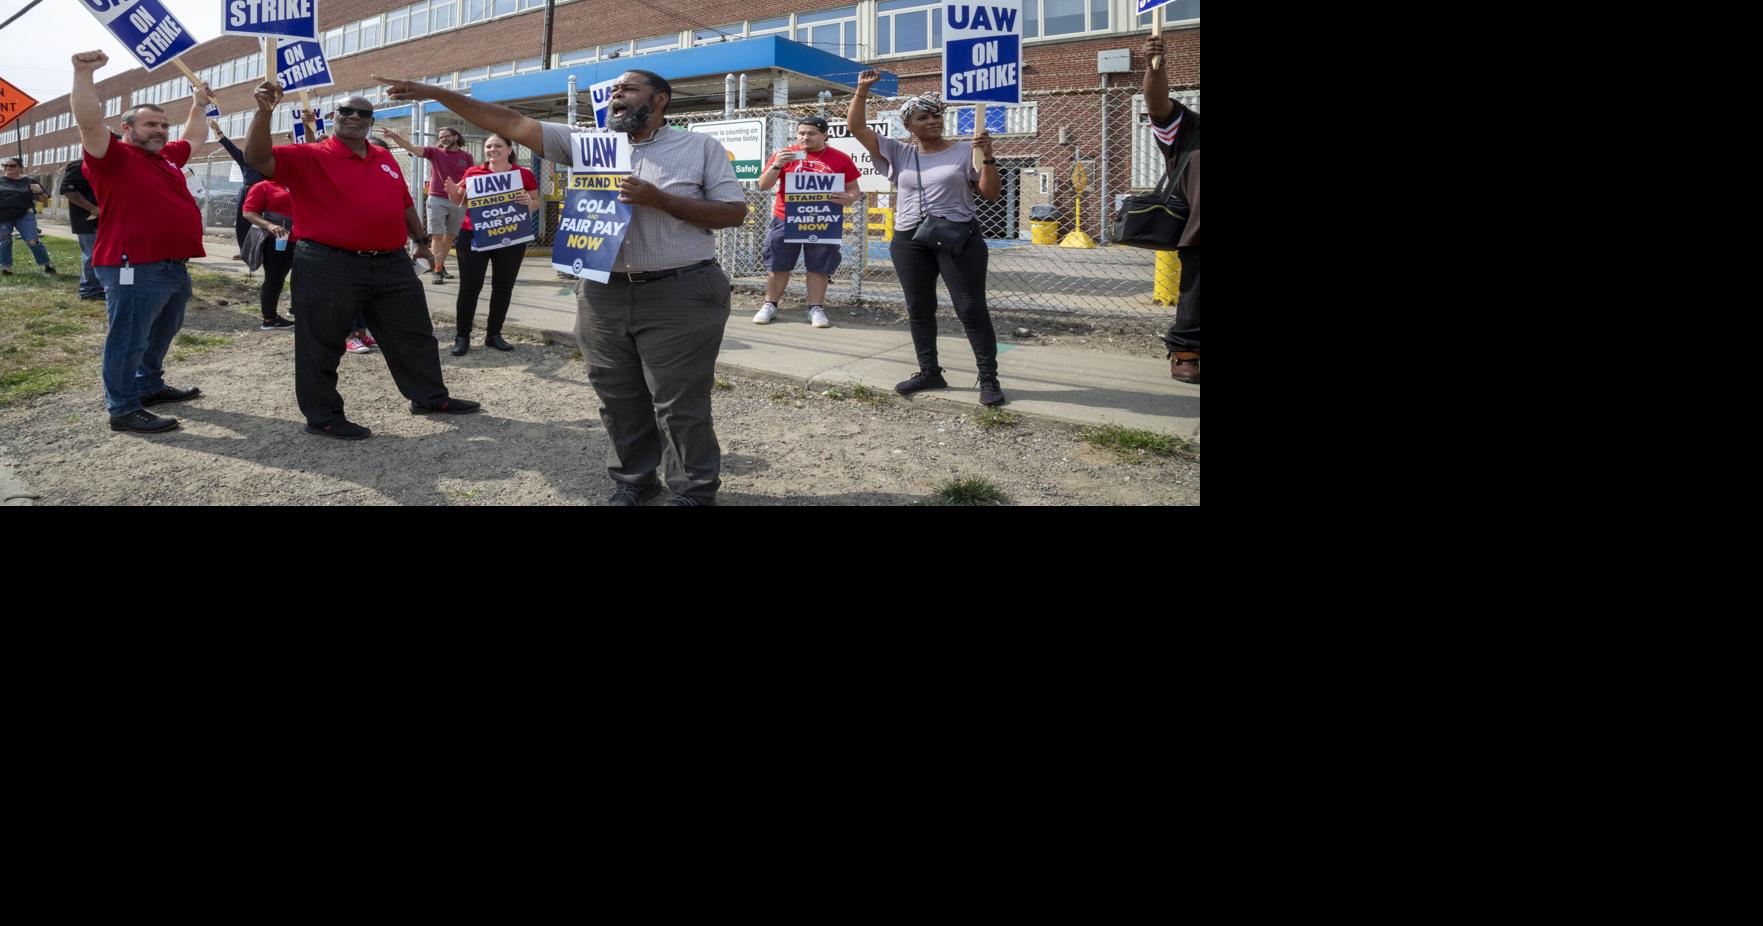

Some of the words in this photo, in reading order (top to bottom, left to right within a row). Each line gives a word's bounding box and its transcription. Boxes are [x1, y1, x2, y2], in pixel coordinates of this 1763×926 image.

[129, 5, 157, 33] ON
[230, 0, 311, 27] STRIKE
[948, 5, 1018, 32] UAW
[136, 14, 182, 64] STRIKE
[284, 44, 305, 66] ON
[972, 40, 999, 66] ON
[277, 55, 325, 89] STRIKE
[950, 62, 1017, 97] STRIKE
[725, 127, 750, 136] counting
[580, 137, 617, 168] UAW
[735, 165, 759, 175] Safely
[474, 173, 512, 194] UAW
[574, 177, 611, 188] STAND
[795, 175, 836, 191] UAW
[470, 196, 505, 207] STAND
[577, 198, 616, 215] COLA
[797, 205, 831, 213] COLA
[481, 205, 517, 218] COLA
[787, 215, 815, 224] FAIR
[817, 215, 841, 223] PAY
[474, 219, 503, 231] FAIR
[504, 212, 527, 225] PAY
[488, 223, 518, 237] NOW
[560, 217, 592, 234] FAIR
[592, 220, 626, 236] PAY
[798, 223, 829, 231] NOW
[566, 234, 604, 251] NOW
